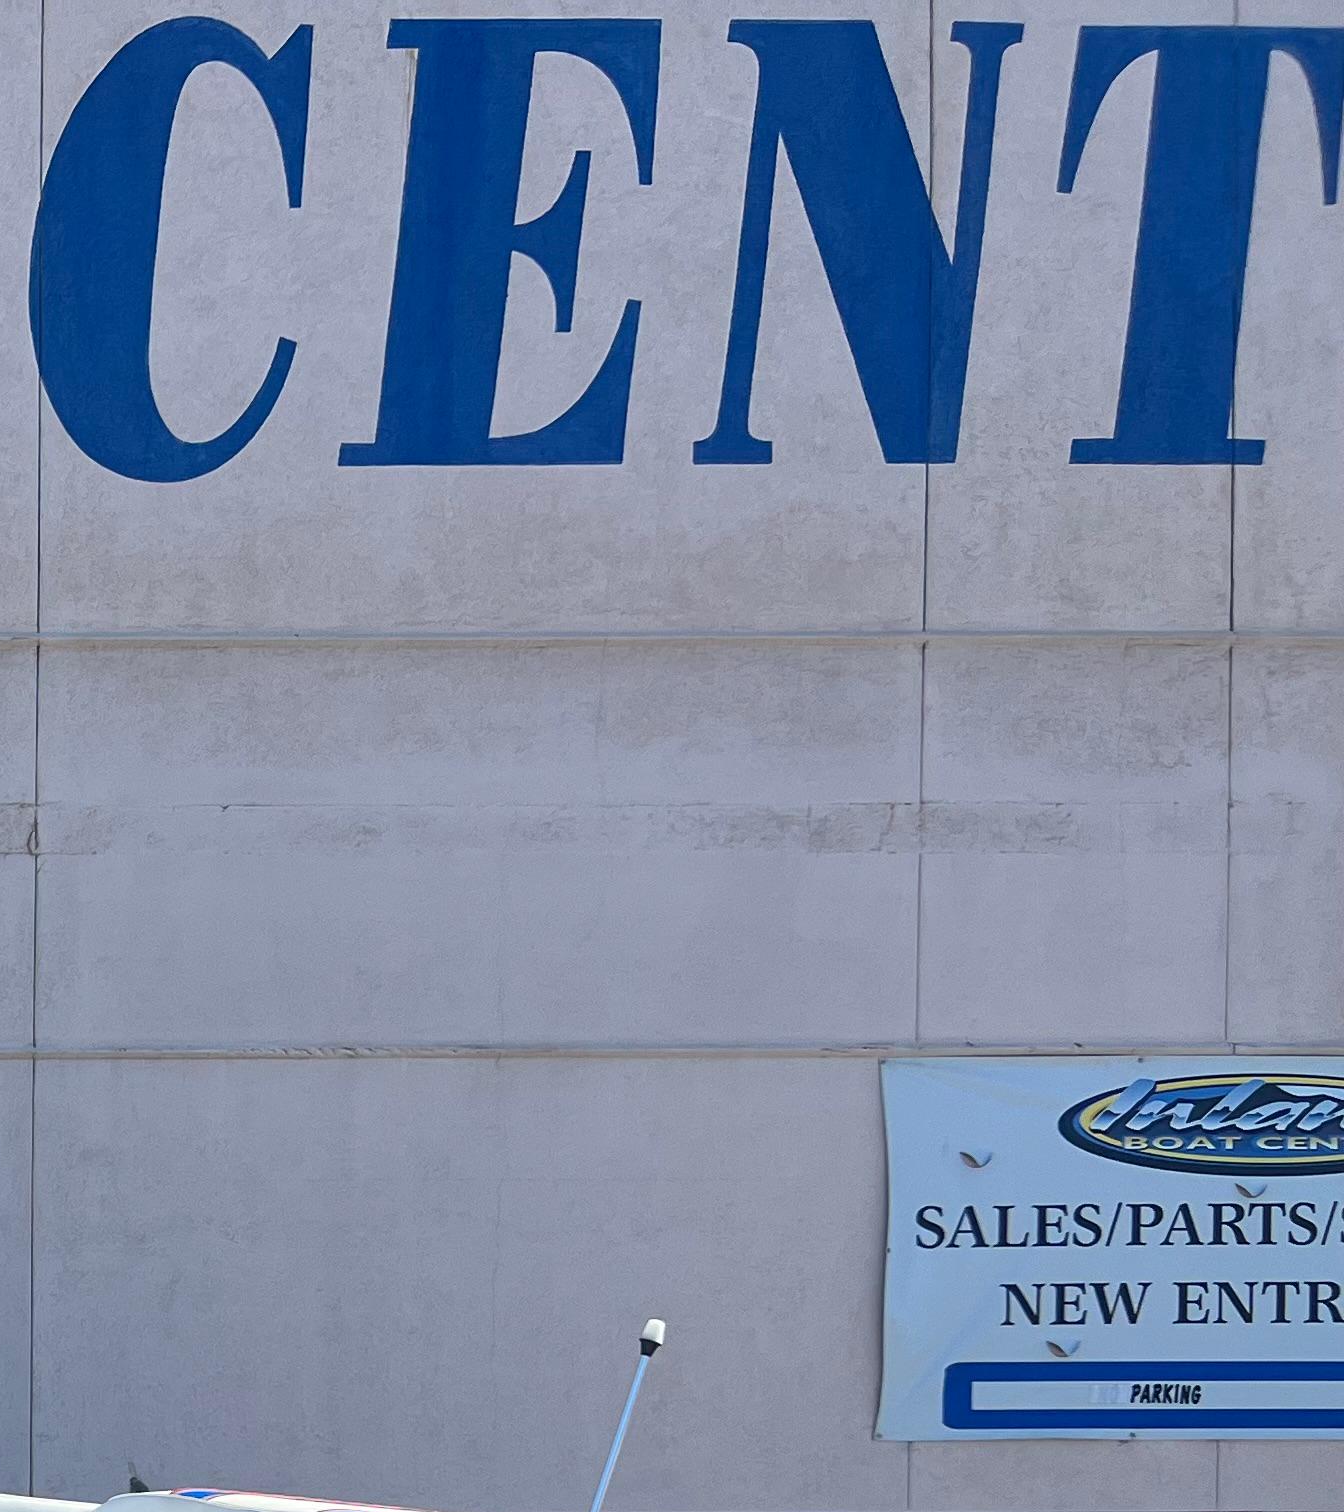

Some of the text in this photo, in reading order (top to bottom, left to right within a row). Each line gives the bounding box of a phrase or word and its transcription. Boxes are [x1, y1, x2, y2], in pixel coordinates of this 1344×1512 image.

[29, 17, 1344, 483] CENT
[1123, 1136, 1344, 1150] BOAT CEN
[915, 1200, 1344, 1249] SALES/PARTS/
[1000, 1280, 1344, 1326] NEW ENTR
[1130, 1383, 1202, 1405] PARKING
